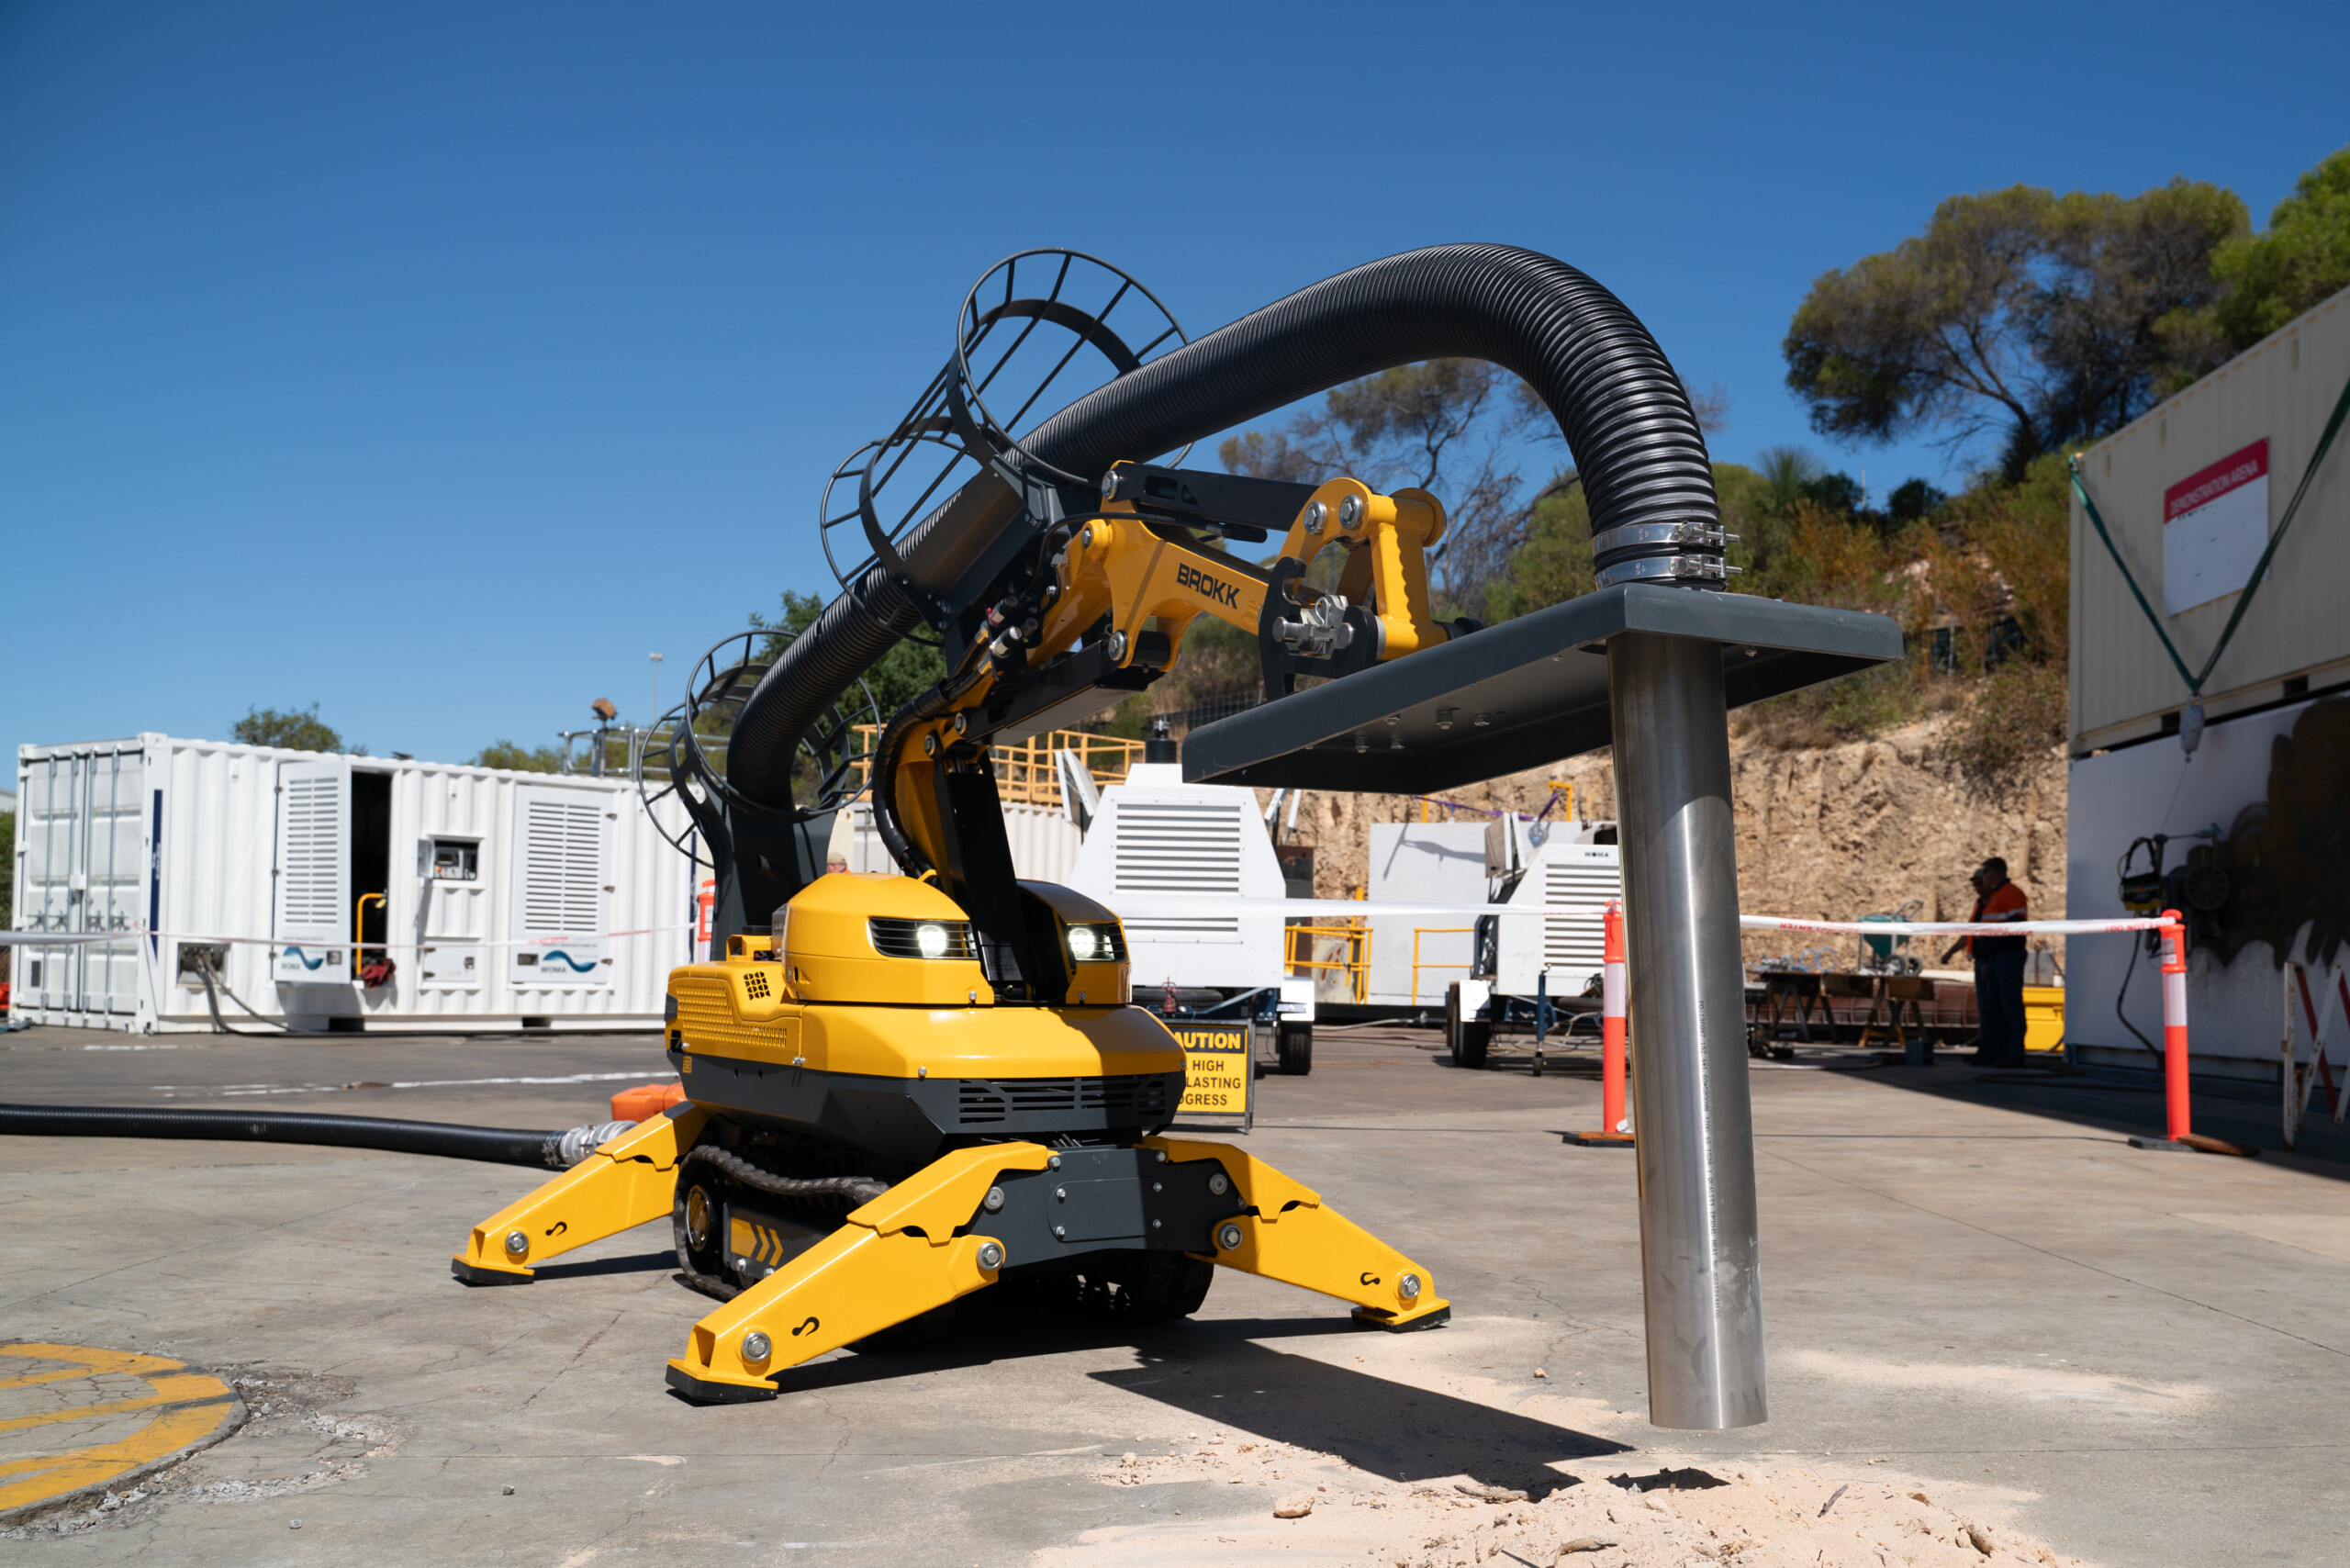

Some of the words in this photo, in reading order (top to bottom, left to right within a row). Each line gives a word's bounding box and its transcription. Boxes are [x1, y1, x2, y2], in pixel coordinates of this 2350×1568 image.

[2170, 474, 2230, 515] DEMONSTRATION
[2230, 459, 2259, 483] ARENA
[1177, 563, 1240, 610] BROKK
[1174, 1032, 1241, 1049] AUTION
[1192, 1060, 1224, 1071] HIGH
[1186, 1077, 1241, 1089] LASTING
